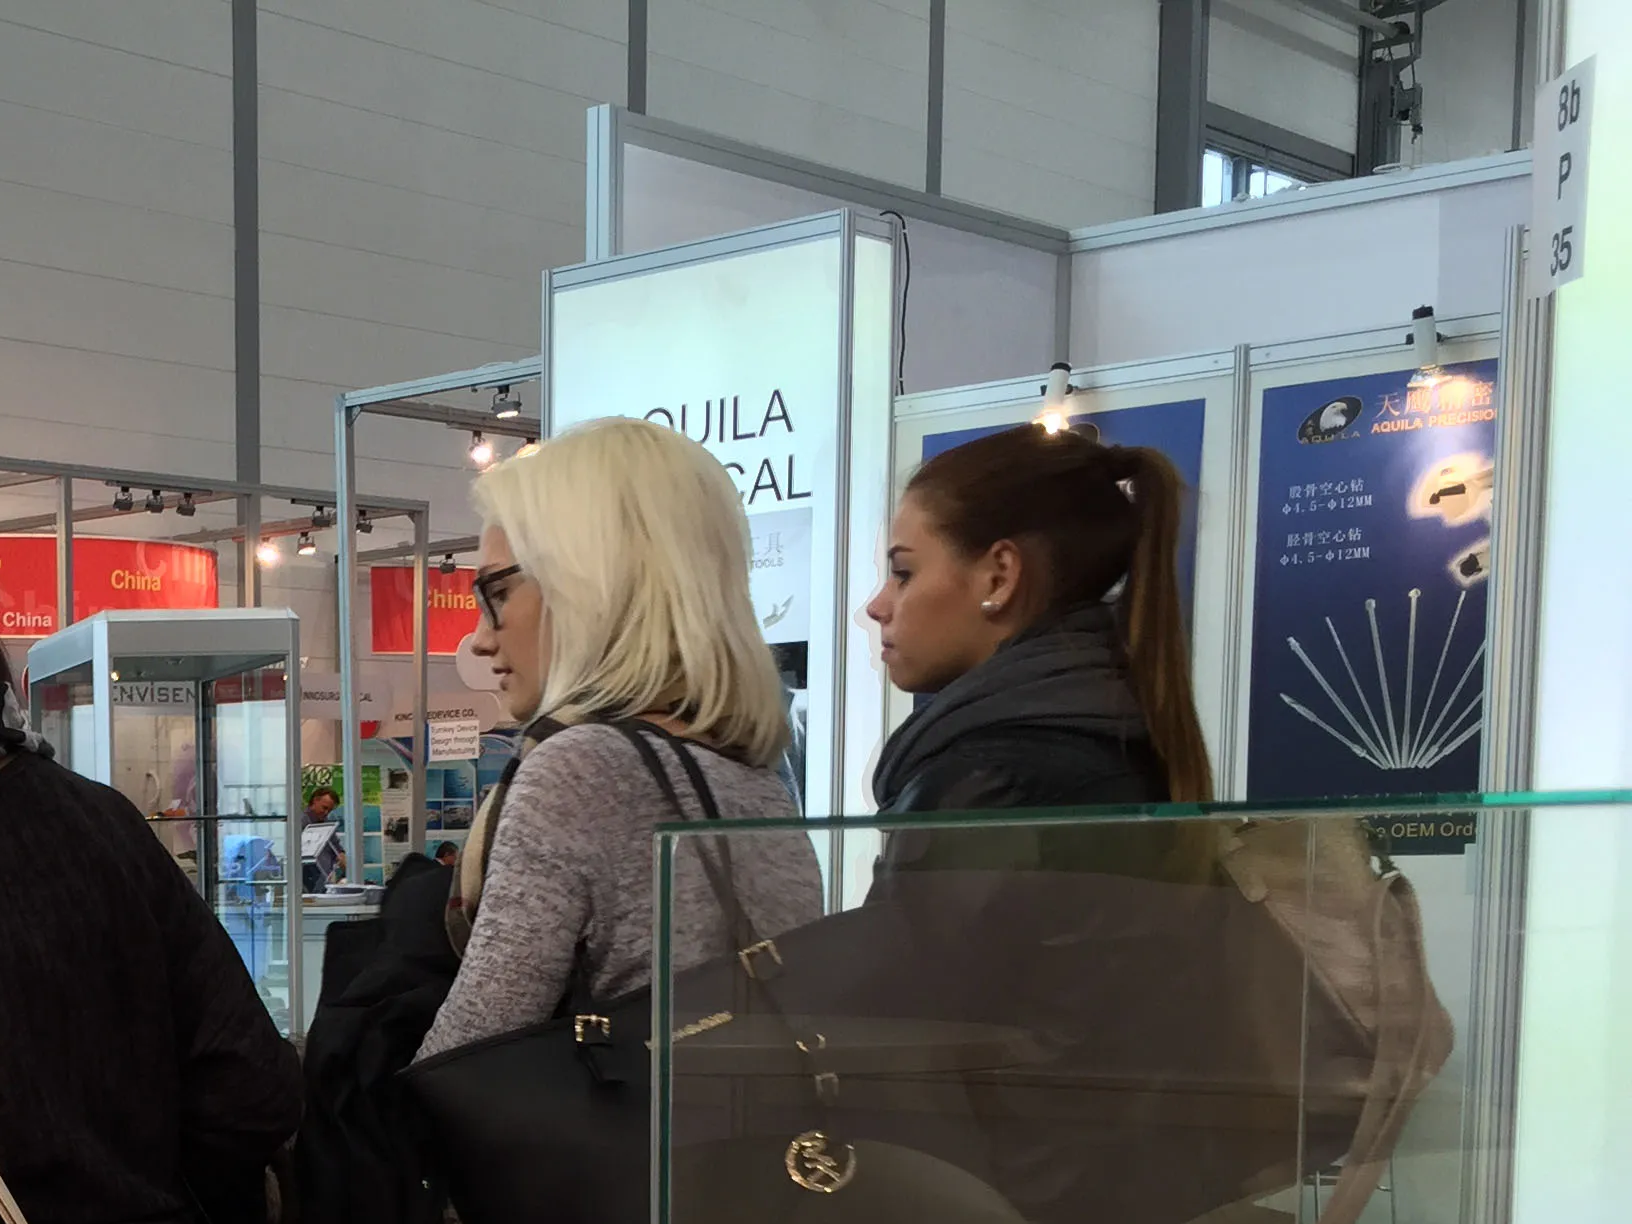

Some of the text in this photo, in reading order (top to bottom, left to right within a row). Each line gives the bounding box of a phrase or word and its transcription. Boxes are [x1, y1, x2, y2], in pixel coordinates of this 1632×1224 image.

[1556, 79, 1581, 132] 8b
[1556, 151, 1572, 201] P
[1550, 225, 1574, 277] 35
[644, 388, 794, 444] UILA
[1371, 416, 1423, 434] AQUILA
[111, 569, 161, 592] China
[427, 588, 477, 610] hina
[2, 611, 52, 628] China
[1391, 822, 1435, 838] OEM
